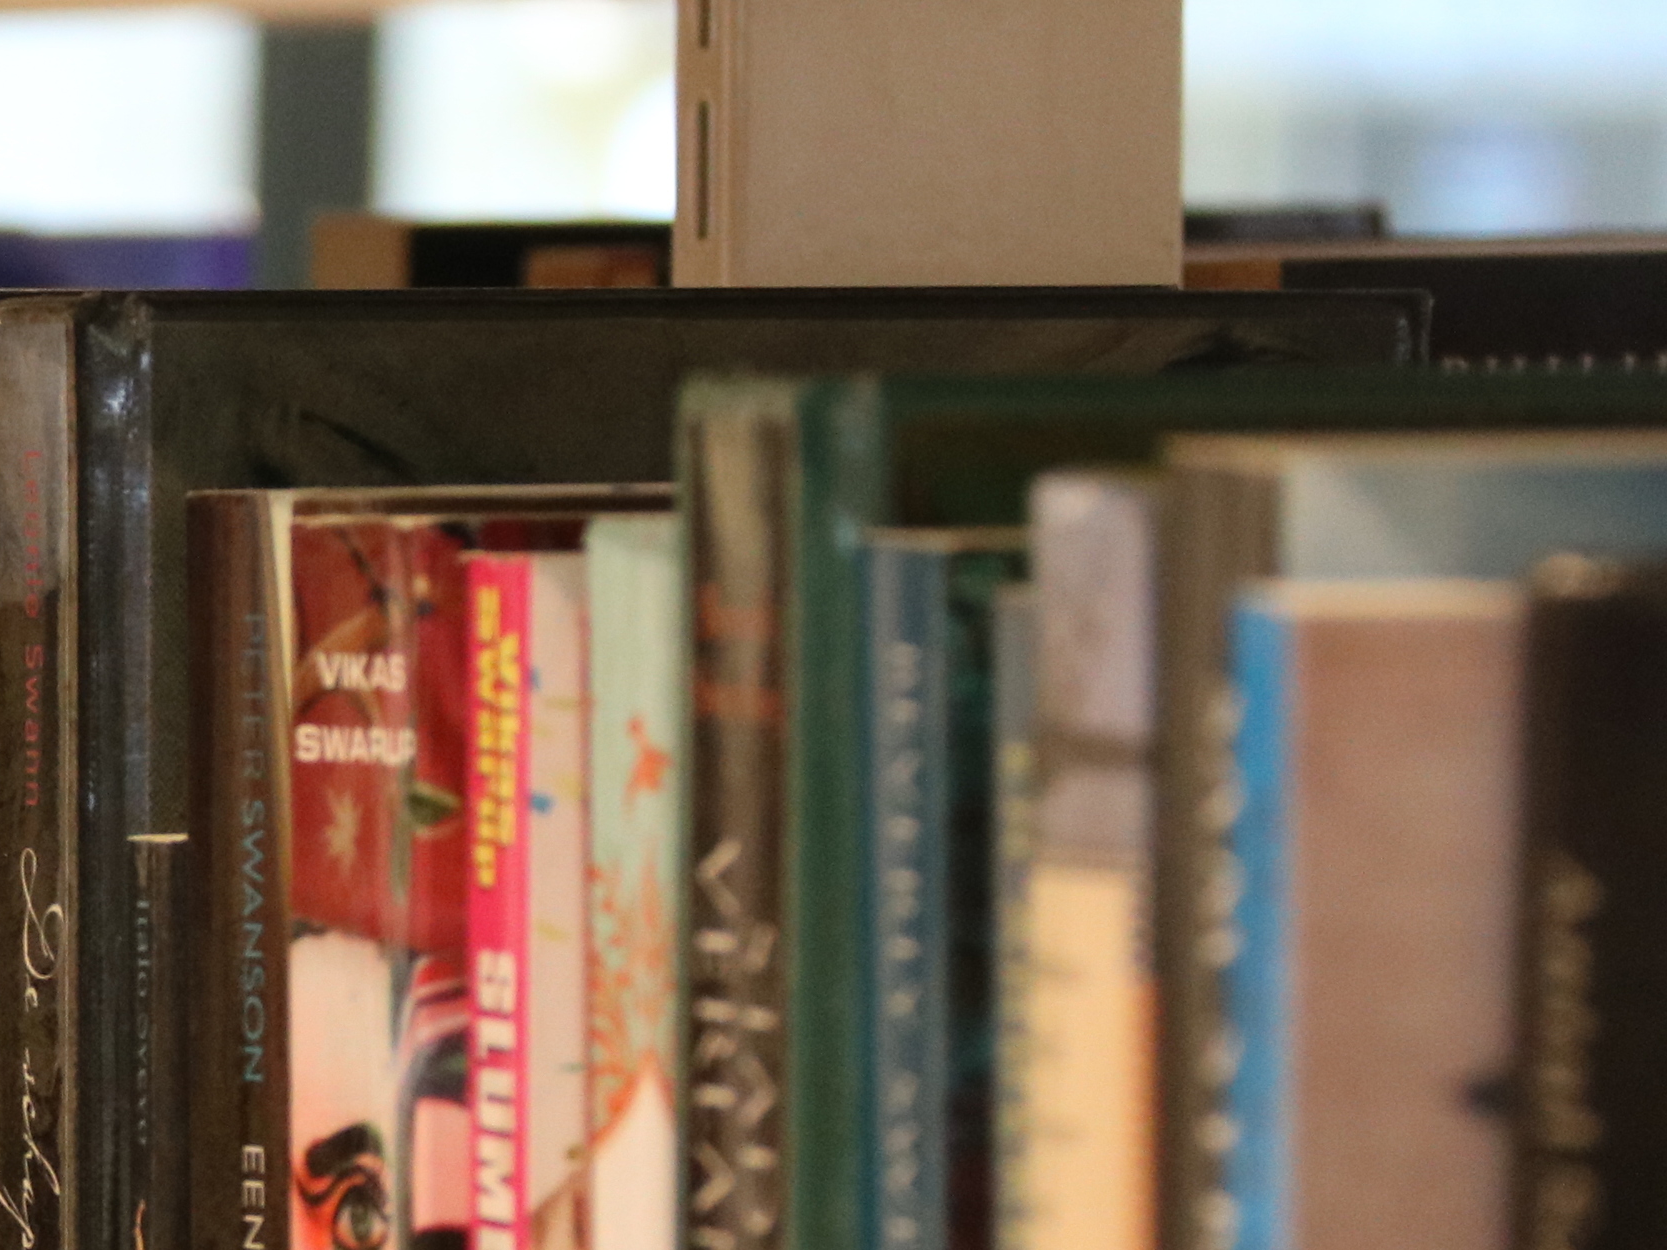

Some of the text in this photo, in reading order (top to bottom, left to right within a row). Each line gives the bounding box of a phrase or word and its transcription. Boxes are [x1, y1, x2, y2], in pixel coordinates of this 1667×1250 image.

[315, 650, 409, 695] VIKAS
[22, 643, 45, 808] Swann
[294, 724, 417, 768] SWARUP
[241, 613, 265, 1084] PETER SWANSON
